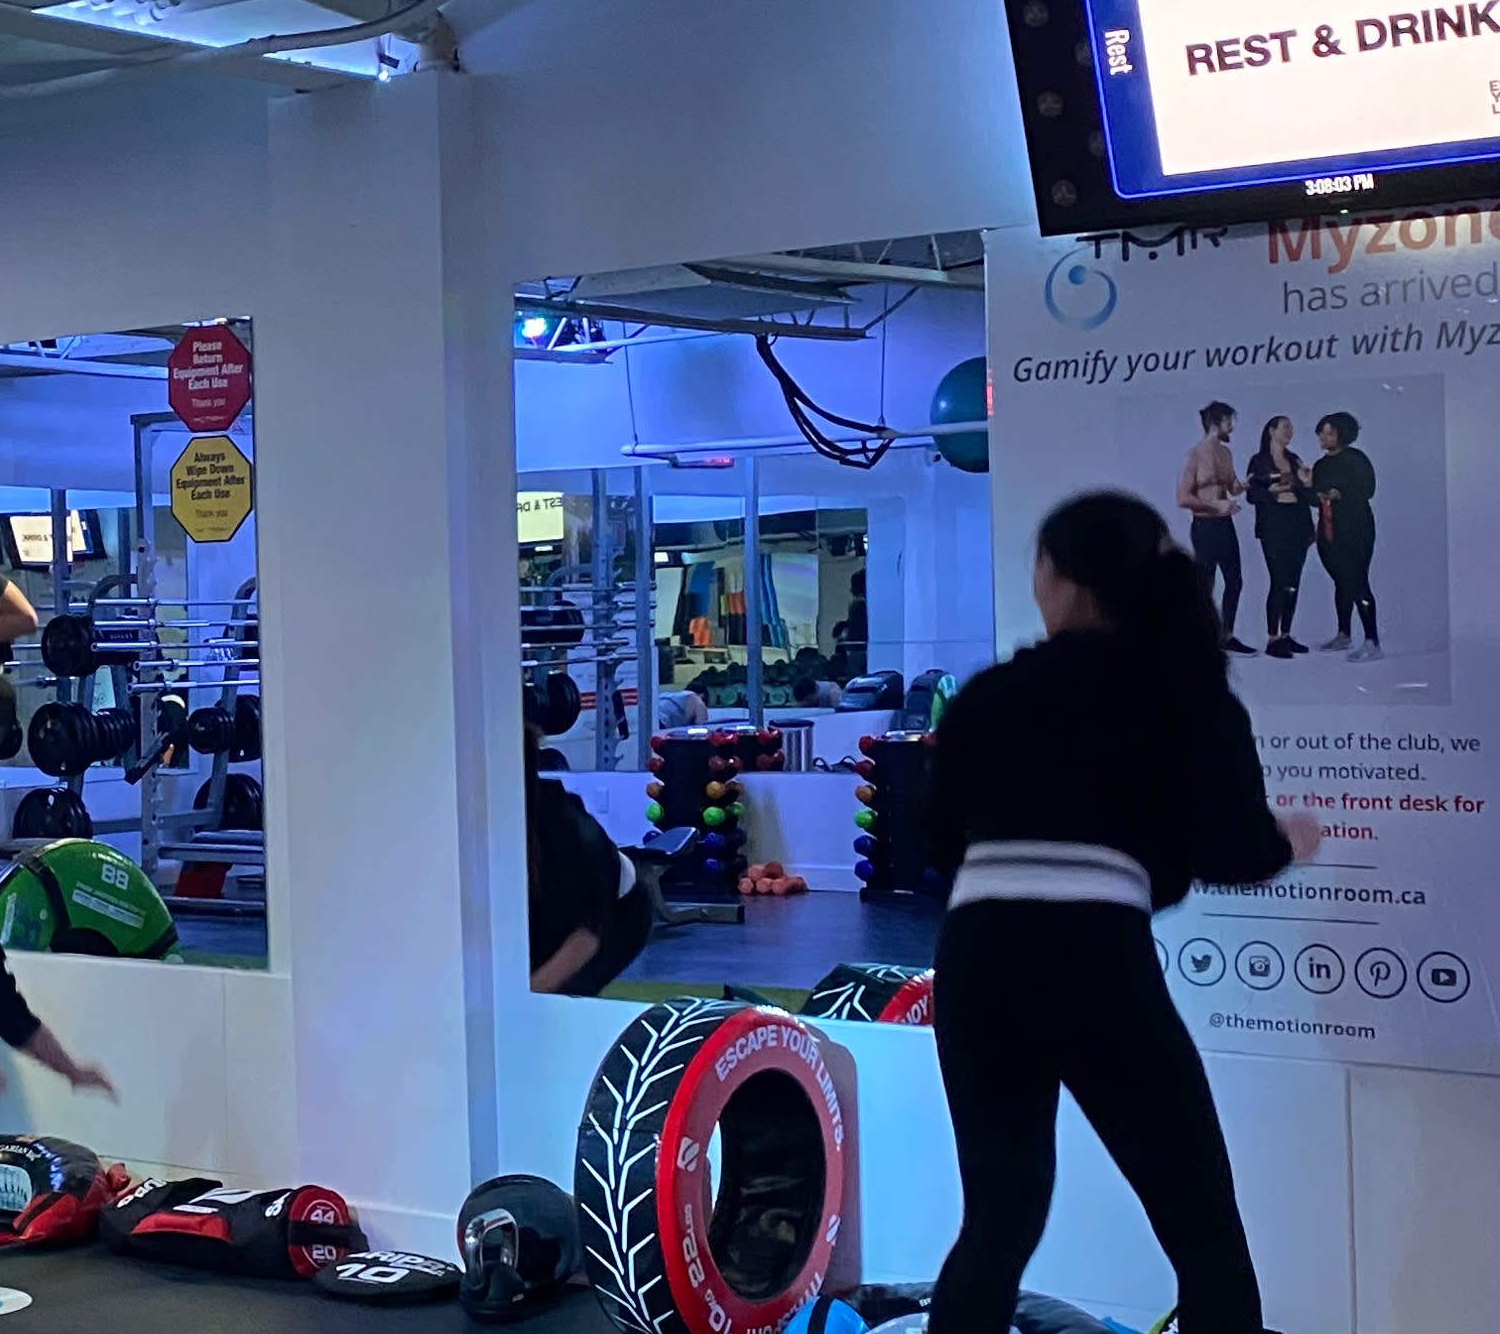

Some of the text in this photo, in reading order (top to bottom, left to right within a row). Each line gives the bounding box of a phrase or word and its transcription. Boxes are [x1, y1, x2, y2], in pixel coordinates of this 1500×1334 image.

[1103, 28, 1133, 76] Rest
[1185, 29, 1299, 77] REST
[1311, 23, 1347, 58] &
[1305, 172, 1375, 197] 3:08:03 PM
[1268, 200, 1500, 273] Myzon
[1283, 261, 1499, 315] has arrived
[192, 340, 222, 353] Please
[1014, 317, 1500, 384] Gamify your workout with Myz
[173, 363, 244, 381] Equipment After
[187, 376, 229, 390] Each Use
[194, 452, 226, 464] Always
[186, 463, 235, 477] Wipe Down
[176, 476, 222, 490] Equipment
[191, 488, 213, 500] Each
[1269, 735, 1292, 750] or
[1296, 734, 1328, 750] out
[1333, 732, 1354, 750] of
[1359, 733, 1392, 751] the
[1397, 733, 1446, 754] club,
[1451, 737, 1482, 753] we
[1276, 764, 1313, 783] you
[1318, 763, 1428, 782] motivated.
[1276, 791, 1486, 814] or the front desk for
[1320, 822, 1379, 842] ation.
[1208, 1011, 1377, 1040] @themotionroom
[714, 1024, 779, 1083] ESCAPE
[780, 1025, 819, 1071] YOUR
[310, 1209, 335, 1225] 44
[312, 1244, 337, 1261] 20
[336, 1262, 410, 1284] 10
